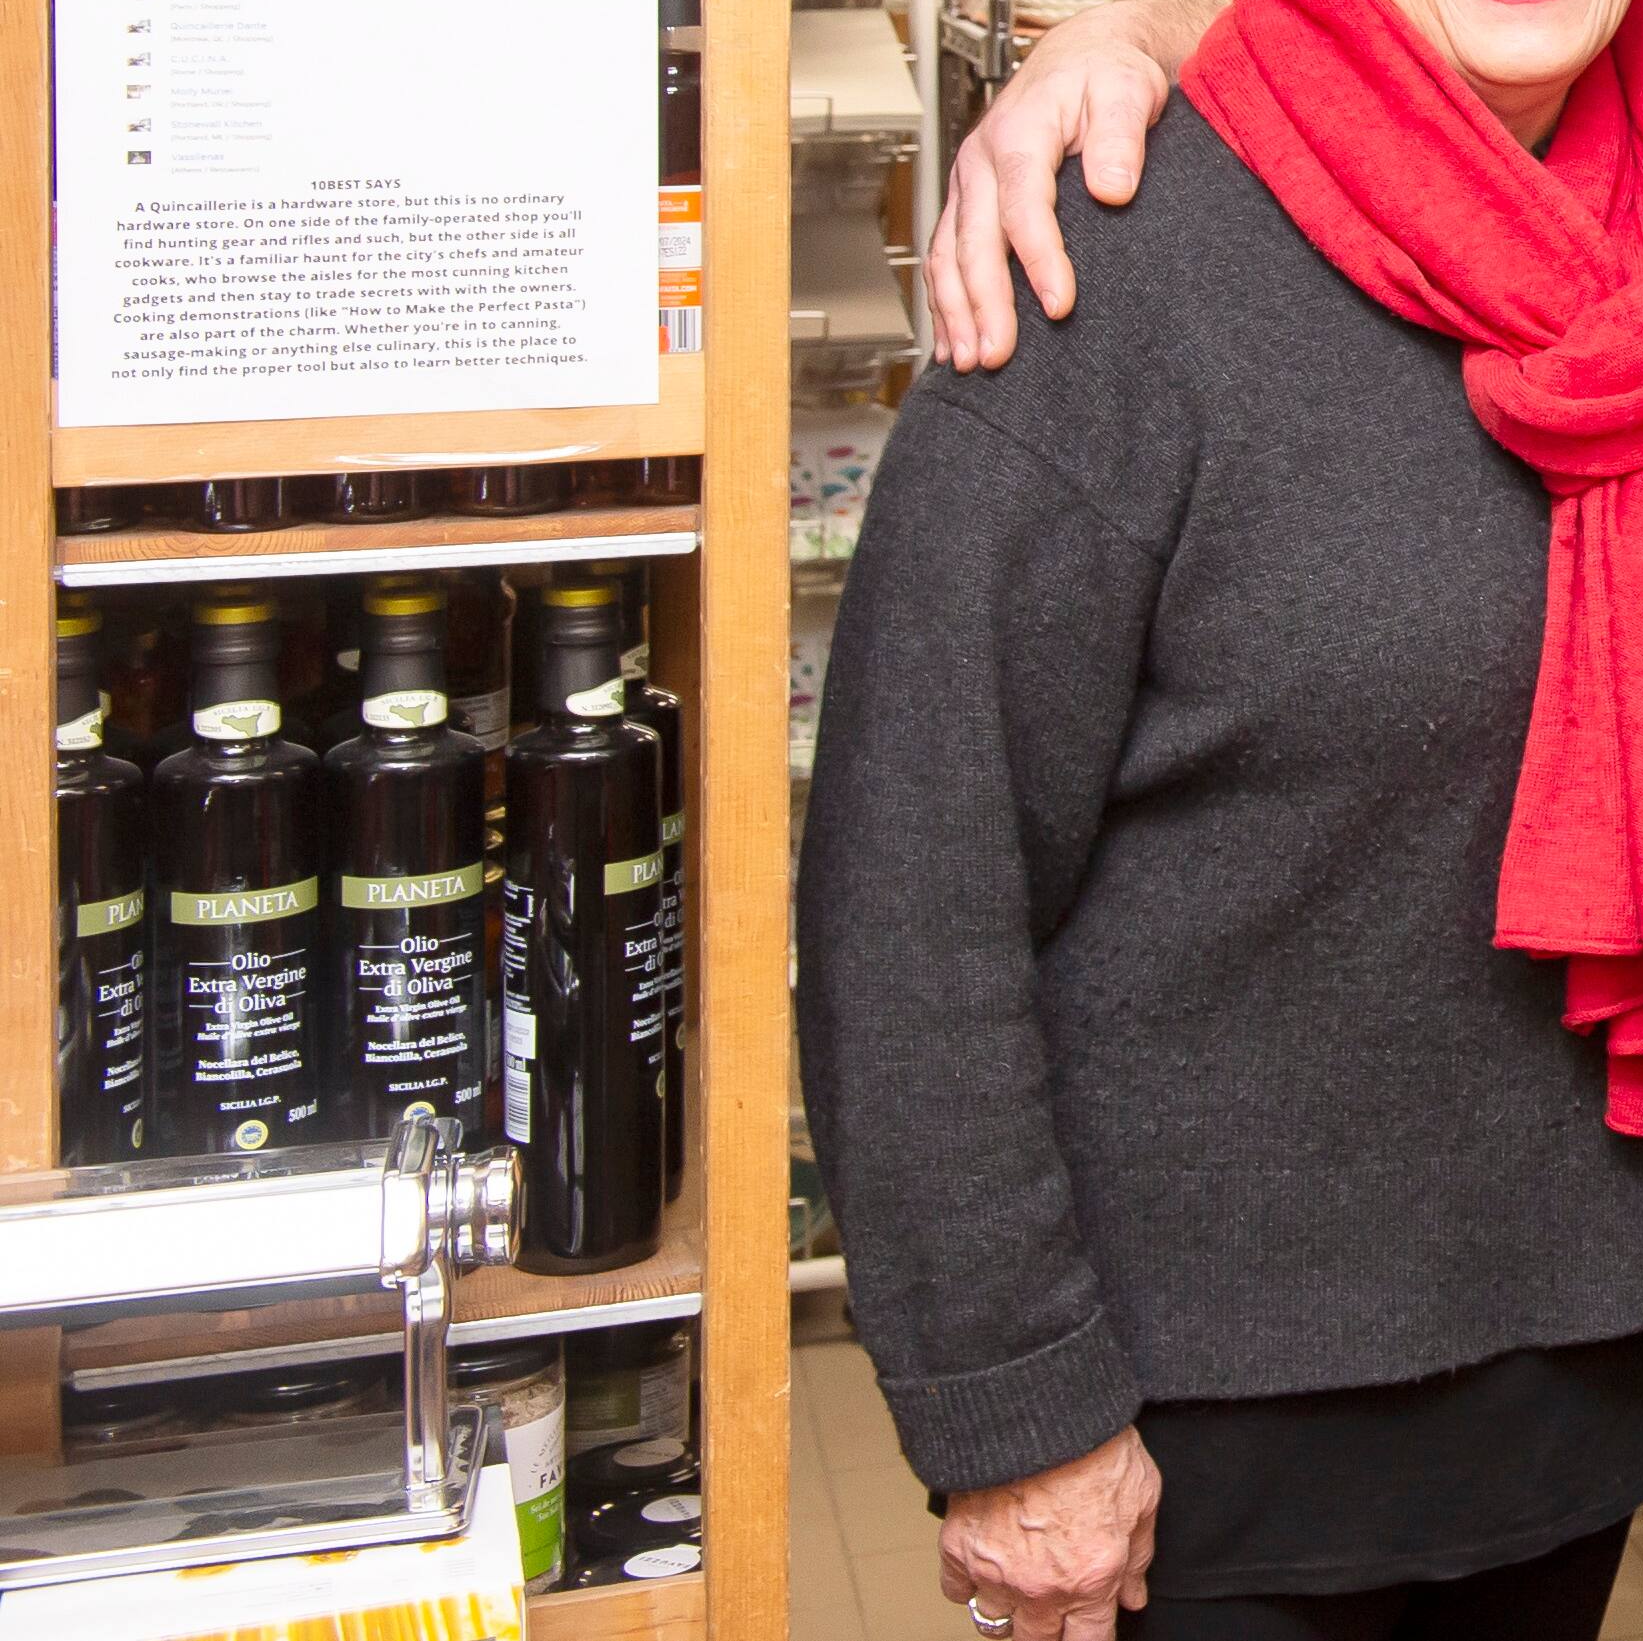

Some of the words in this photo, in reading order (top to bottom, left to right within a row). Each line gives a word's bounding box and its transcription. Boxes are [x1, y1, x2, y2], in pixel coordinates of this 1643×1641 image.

[312, 180, 360, 190] 10BEST
[366, 179, 400, 189] SAYS
[367, 875, 466, 903] PLANETA
[197, 890, 299, 920] PLANETA
[400, 936, 439, 955] Olio
[231, 952, 271, 971] Olio
[359, 959, 406, 977] Extra
[411, 949, 473, 974] Vergine
[189, 976, 237, 994] Extra
[242, 966, 306, 991] Vergine
[383, 980, 402, 997] di
[407, 976, 453, 996] Oliva
[215, 998, 232, 1015] di
[239, 993, 287, 1013] Oliva
